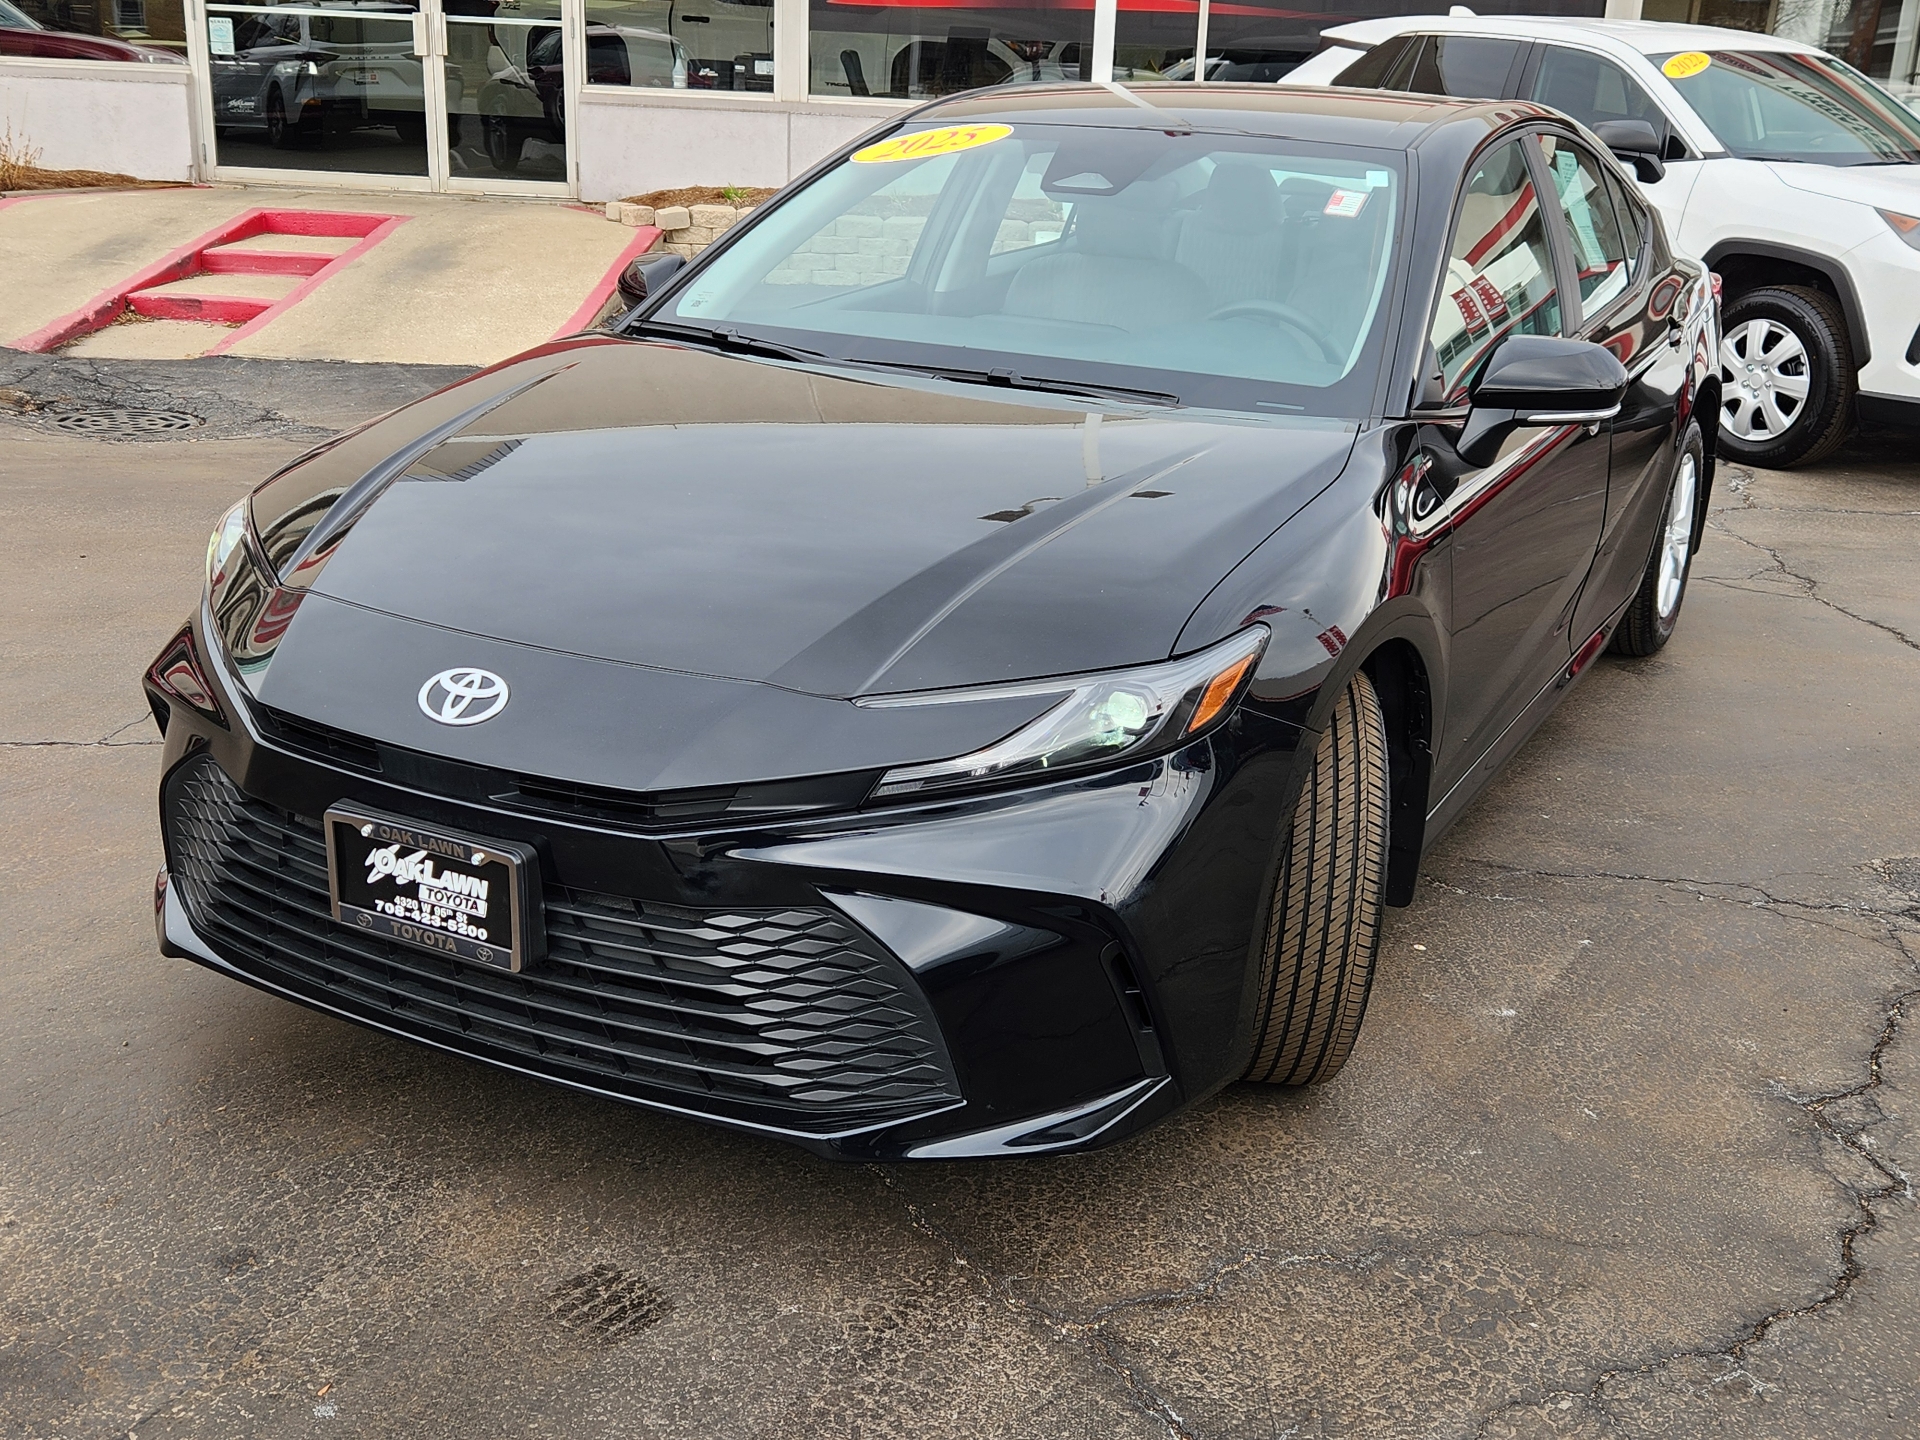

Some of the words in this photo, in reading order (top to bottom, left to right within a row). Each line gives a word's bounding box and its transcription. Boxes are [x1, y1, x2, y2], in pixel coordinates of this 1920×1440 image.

[1670, 53, 1704, 75] 2022
[873, 126, 988, 160] 2025
[380, 825, 415, 846] OAK
[417, 834, 465, 859] LAWN
[393, 895, 419, 911] 4320
[420, 901, 432, 914] W
[455, 911, 468, 924] St
[426, 887, 480, 913] TOYOTA
[374, 898, 488, 941] 708-423-5200
[390, 920, 458, 953] TOYOTA
